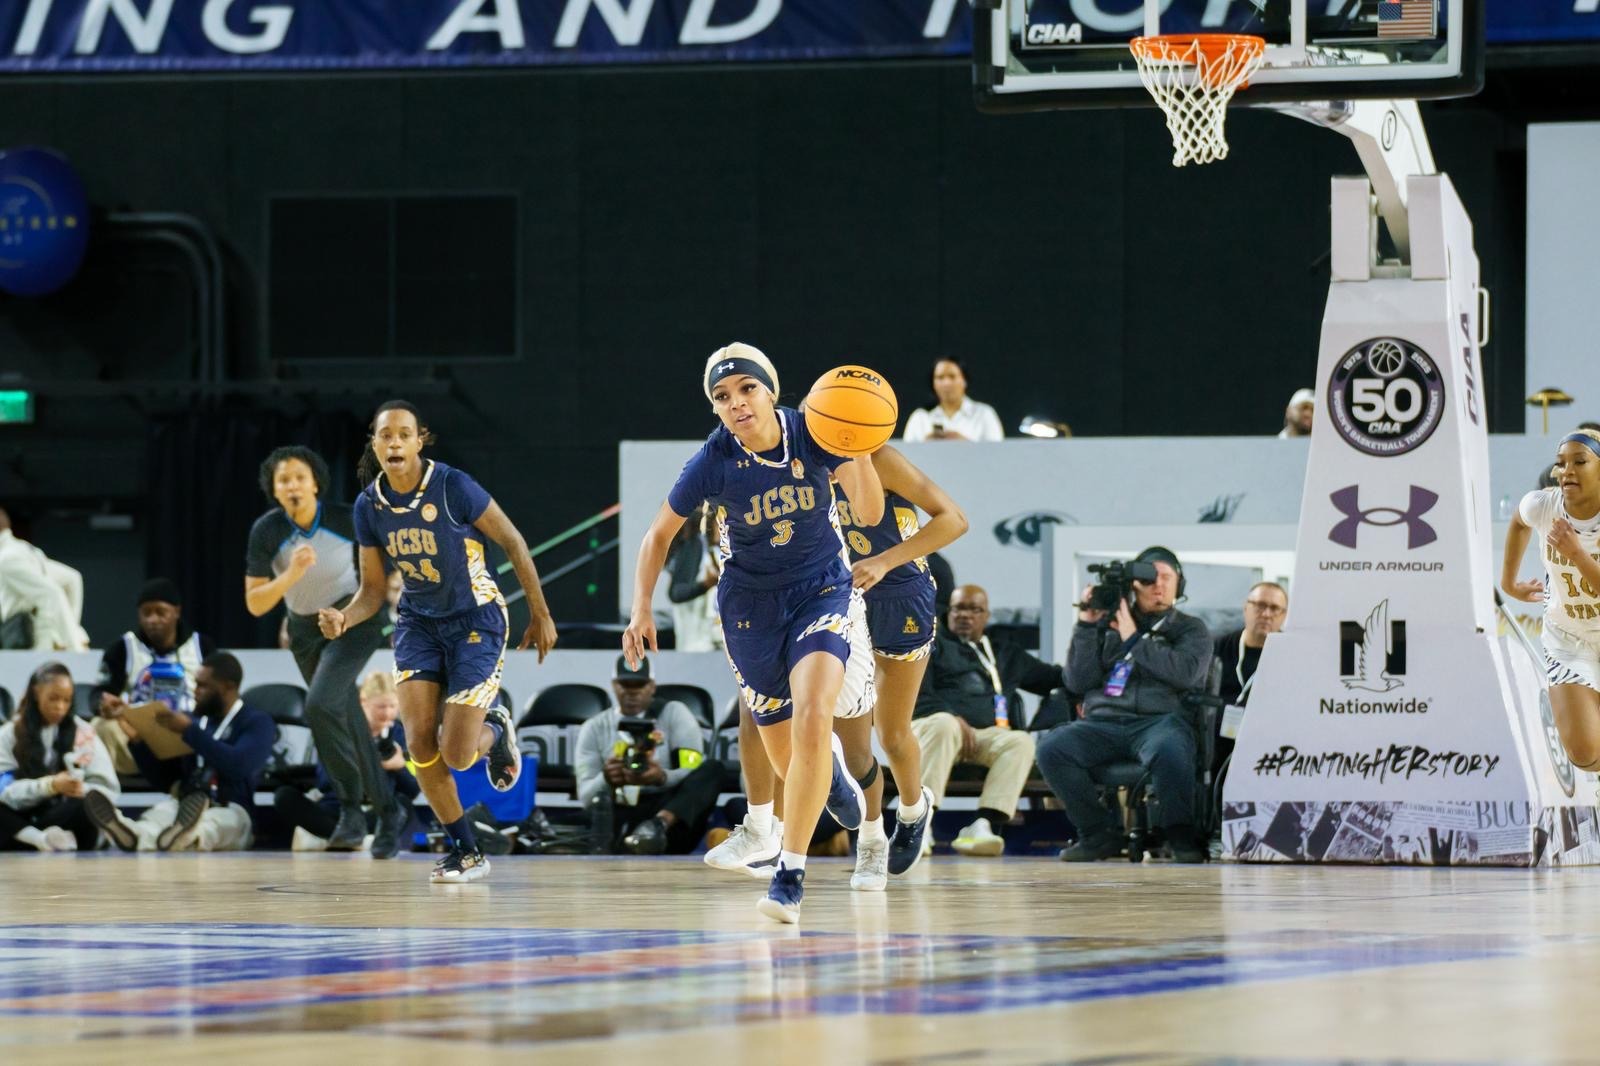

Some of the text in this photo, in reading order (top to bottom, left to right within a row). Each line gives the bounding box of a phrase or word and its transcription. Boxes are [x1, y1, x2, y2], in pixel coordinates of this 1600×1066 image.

[426, 0, 783, 49] AND
[1028, 23, 1083, 44] CIAA
[836, 369, 881, 386] NCAA
[1460, 313, 1478, 426] CIAA
[1351, 378, 1422, 423] 50
[1349, 430, 1405, 451] BASKETBALL
[1404, 390, 1440, 445] TOURNAMENT
[1368, 422, 1402, 434] CIAA
[744, 485, 816, 526] JCSU
[386, 528, 438, 558] JCSU
[1319, 561, 1444, 572] UNDER ARMOUR
[1319, 697, 1429, 714] Nationwide
